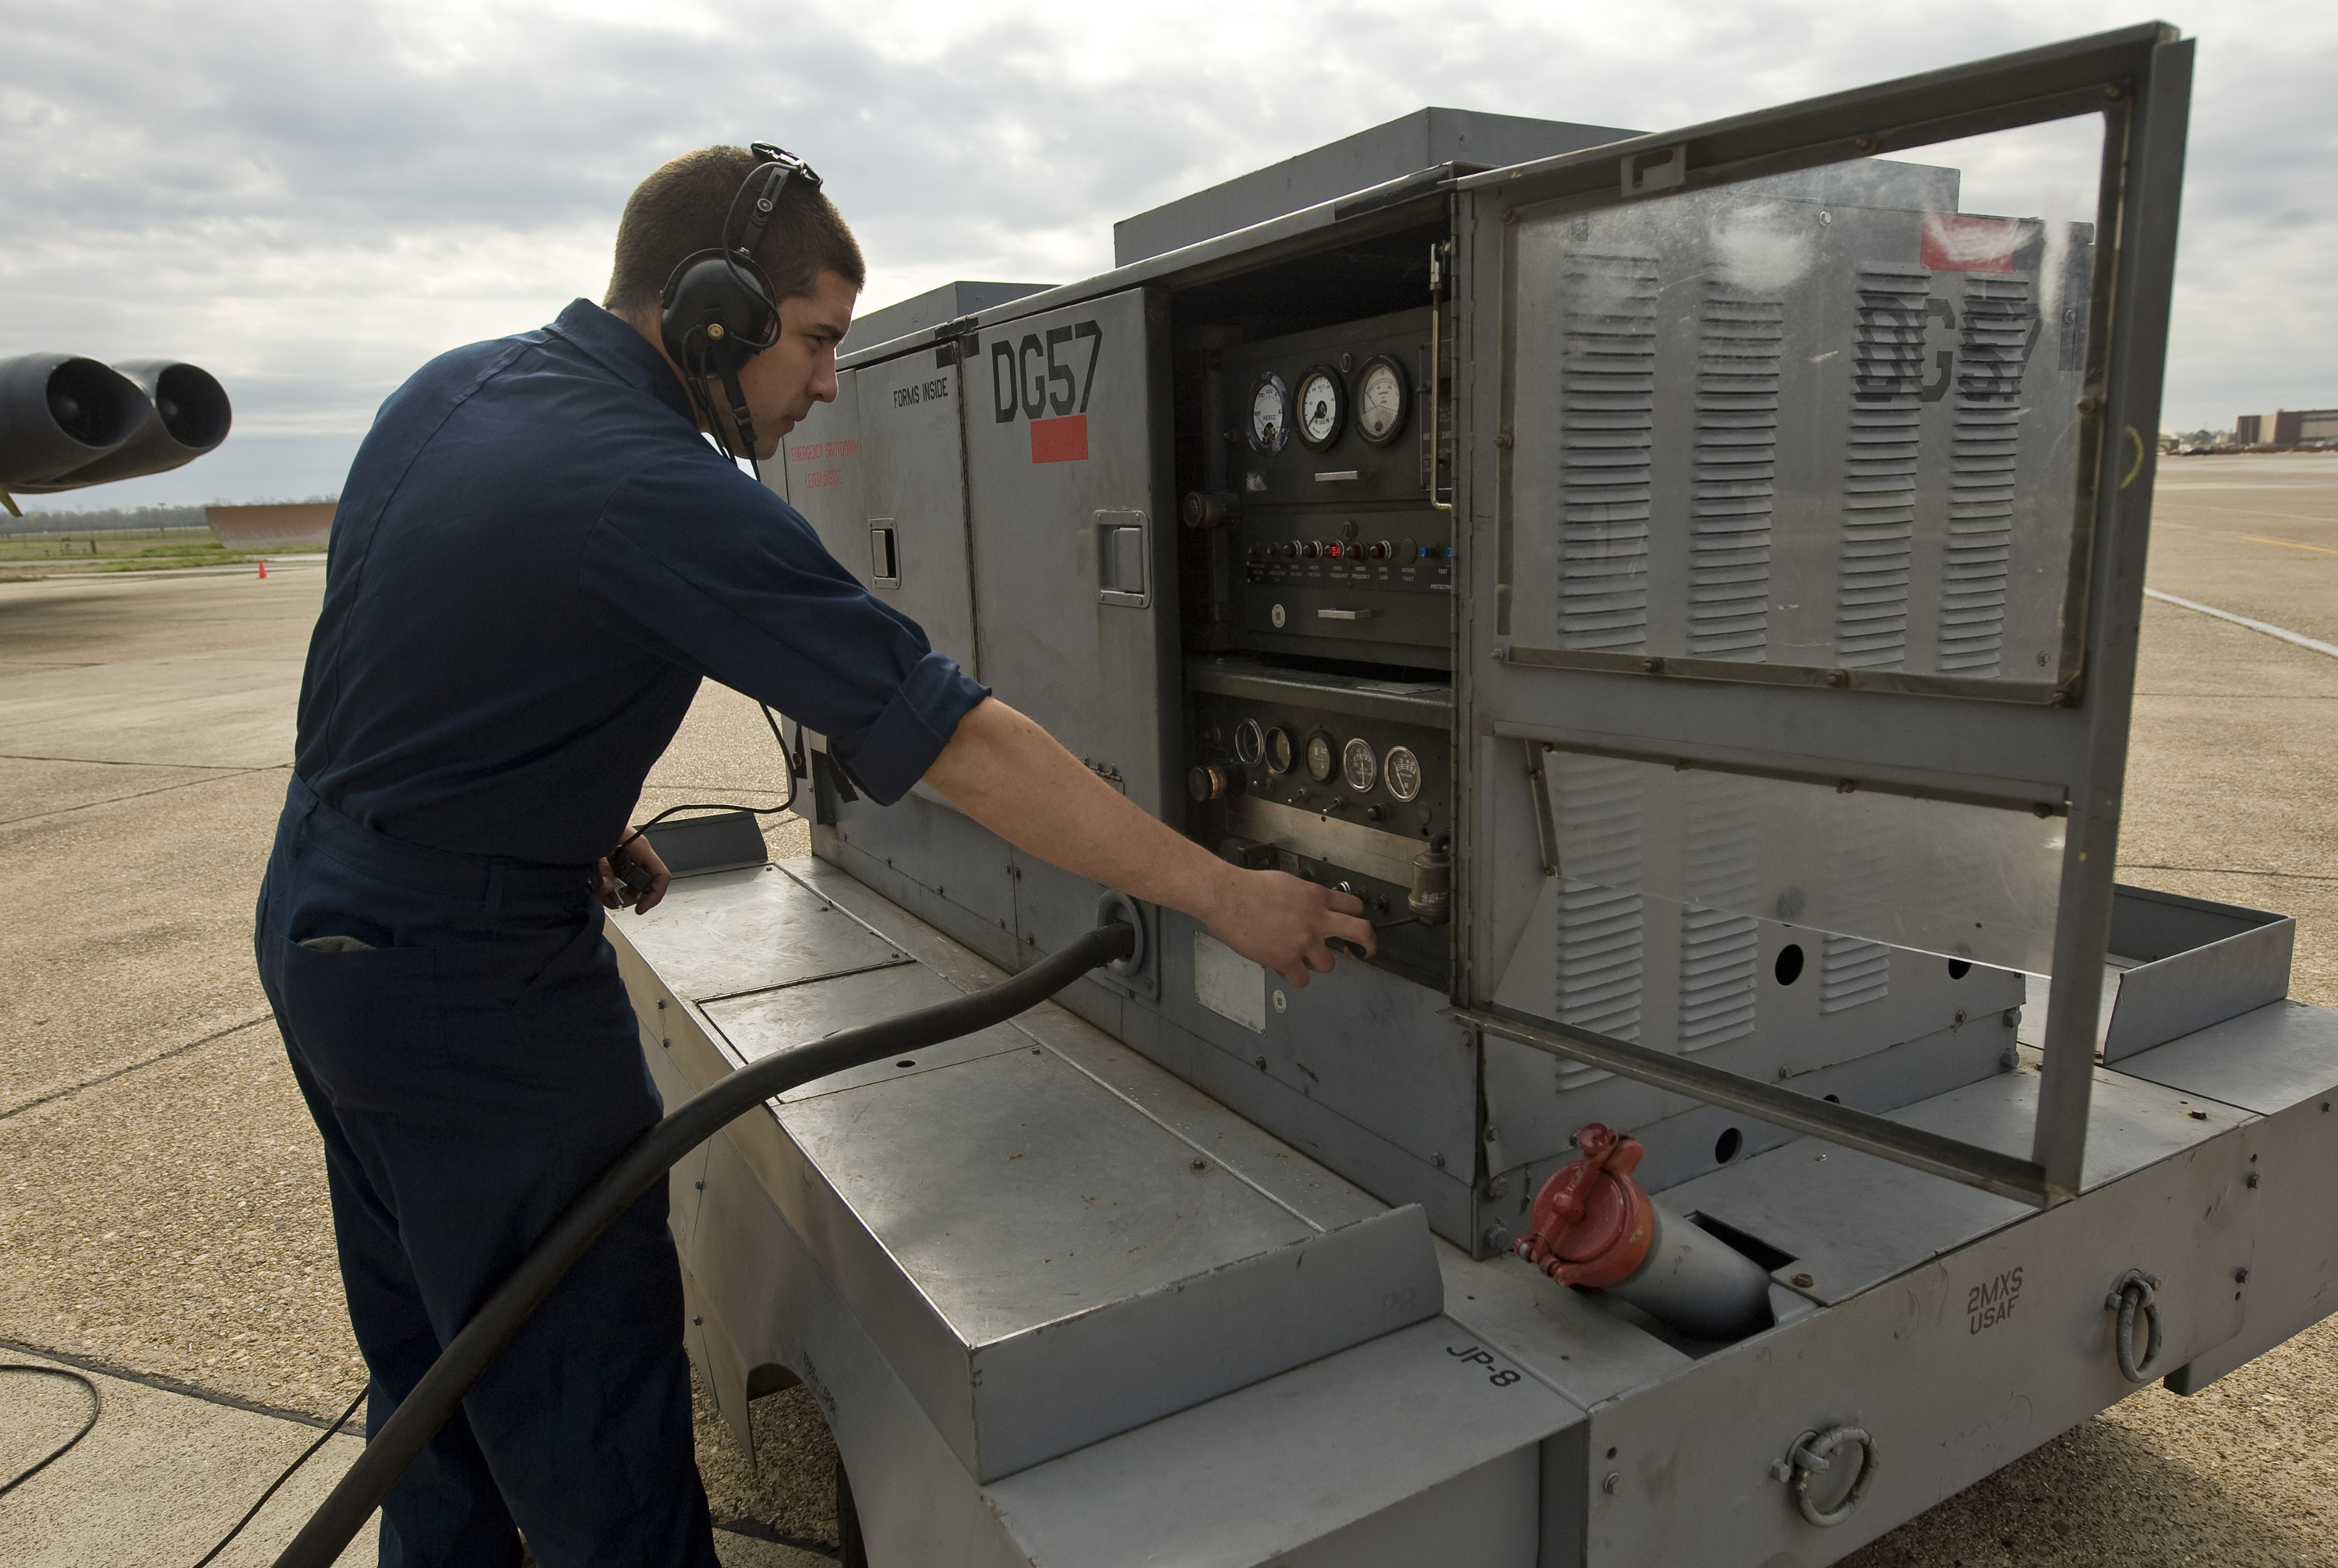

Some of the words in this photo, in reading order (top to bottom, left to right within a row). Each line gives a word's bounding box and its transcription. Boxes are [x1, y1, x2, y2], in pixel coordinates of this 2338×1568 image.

[893, 385, 920, 409] FORMS
[922, 377, 948, 402] INSIDE
[991, 320, 1104, 424] DG57
[791, 443, 823, 462] EMERGENCY
[825, 439, 859, 458] SHUTDOWN
[804, 471, 822, 489] LEVER
[823, 468, 842, 486] INSIDE
[1966, 1266, 2024, 1315] 2MXS
[1969, 1294, 2020, 1336] USAF
[1446, 1344, 1522, 1388] JP-8
